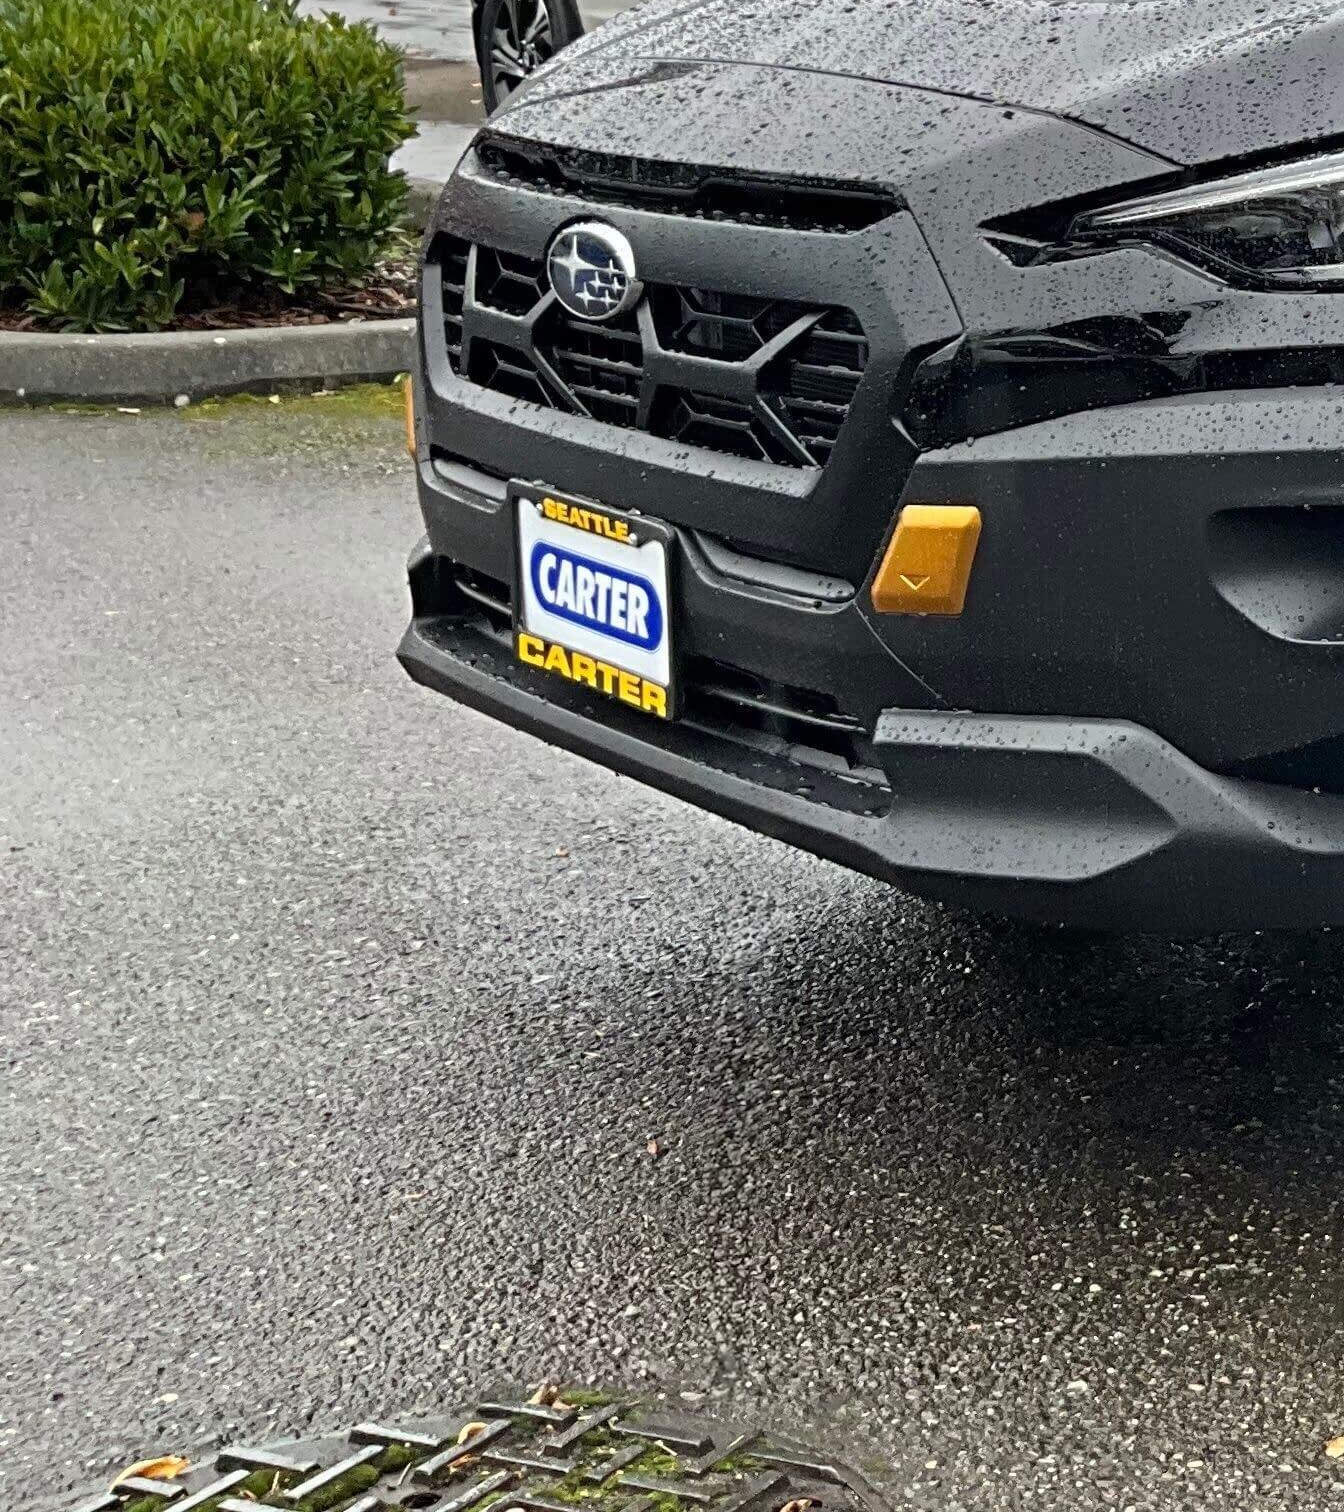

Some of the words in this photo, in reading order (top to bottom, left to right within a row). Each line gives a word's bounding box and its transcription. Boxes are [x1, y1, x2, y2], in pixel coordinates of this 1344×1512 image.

[542, 497, 633, 542] SEATTLE
[538, 552, 650, 639] CARTER
[518, 632, 668, 718] CARTER
